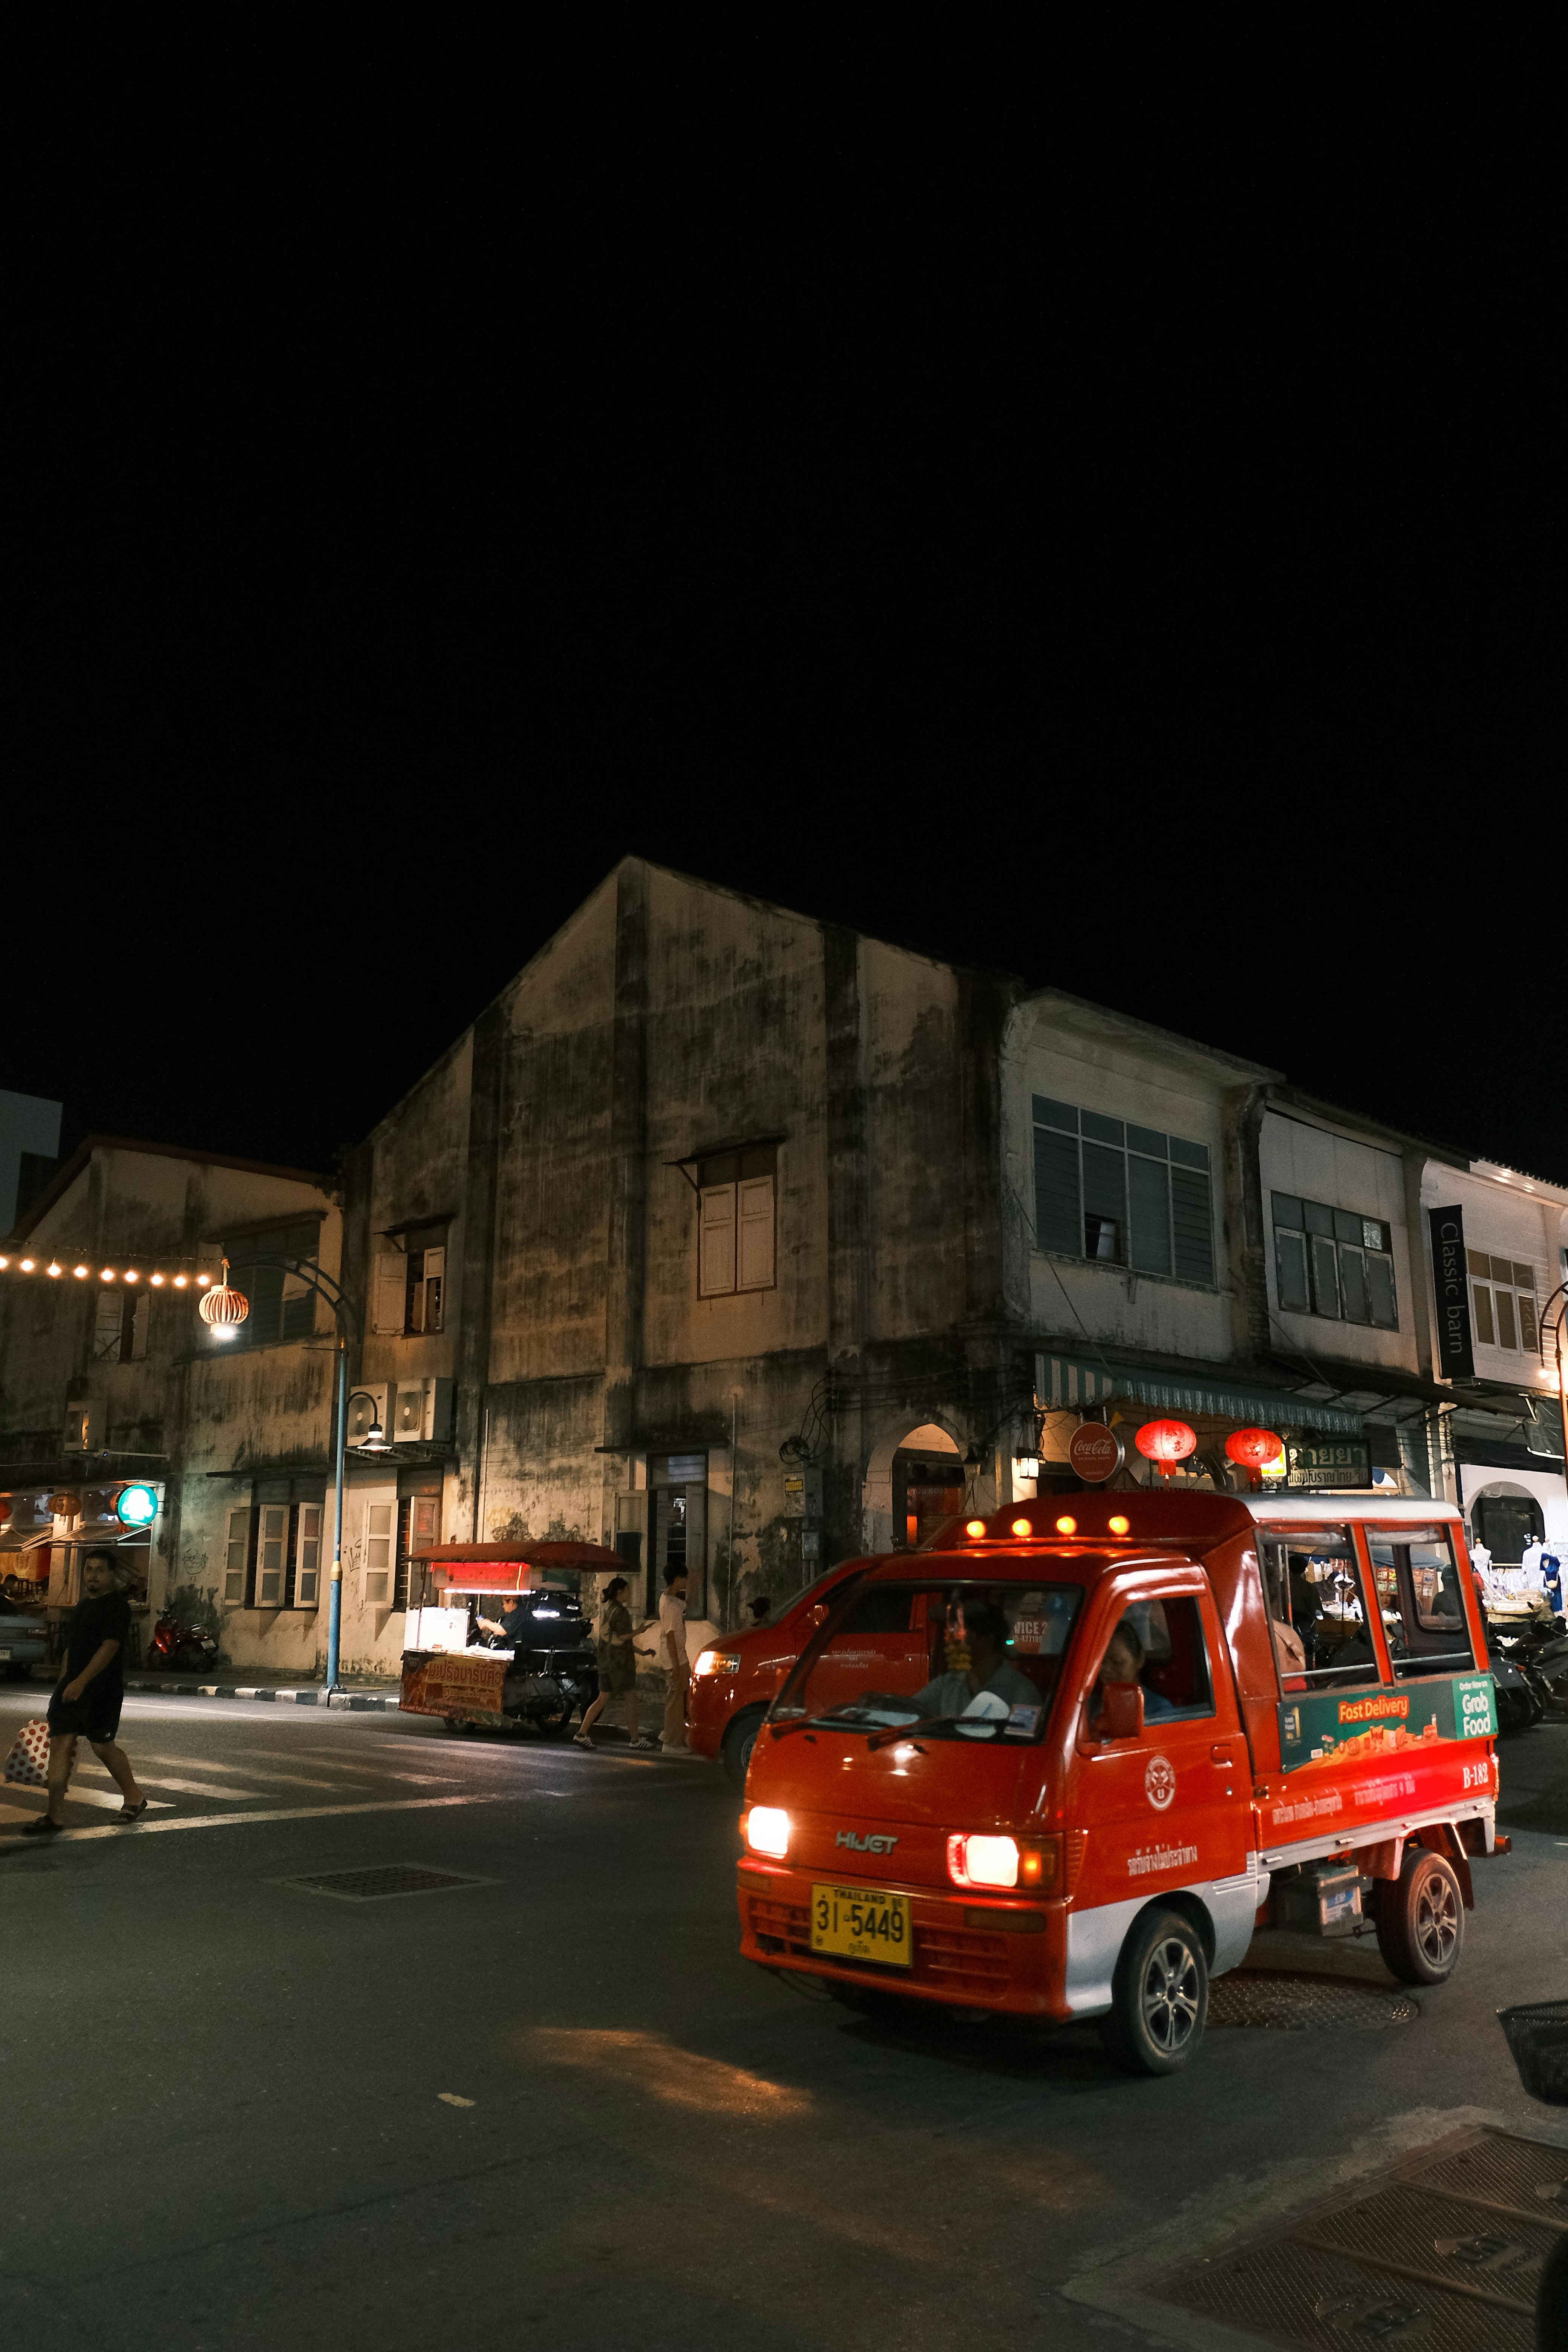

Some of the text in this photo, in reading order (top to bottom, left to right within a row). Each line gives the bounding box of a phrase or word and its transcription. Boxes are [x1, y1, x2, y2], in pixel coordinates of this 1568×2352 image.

[1441, 1222, 1465, 1354] Classic barn
[1074, 1438, 1112, 1456] Coca-Cola
[1340, 1698, 1407, 1721] Fast Delivery
[1462, 1690, 1488, 1714] Grab
[1463, 1712, 1491, 1736] Food
[1462, 1762, 1488, 1789] B-182
[836, 1830, 899, 1854] HIJET
